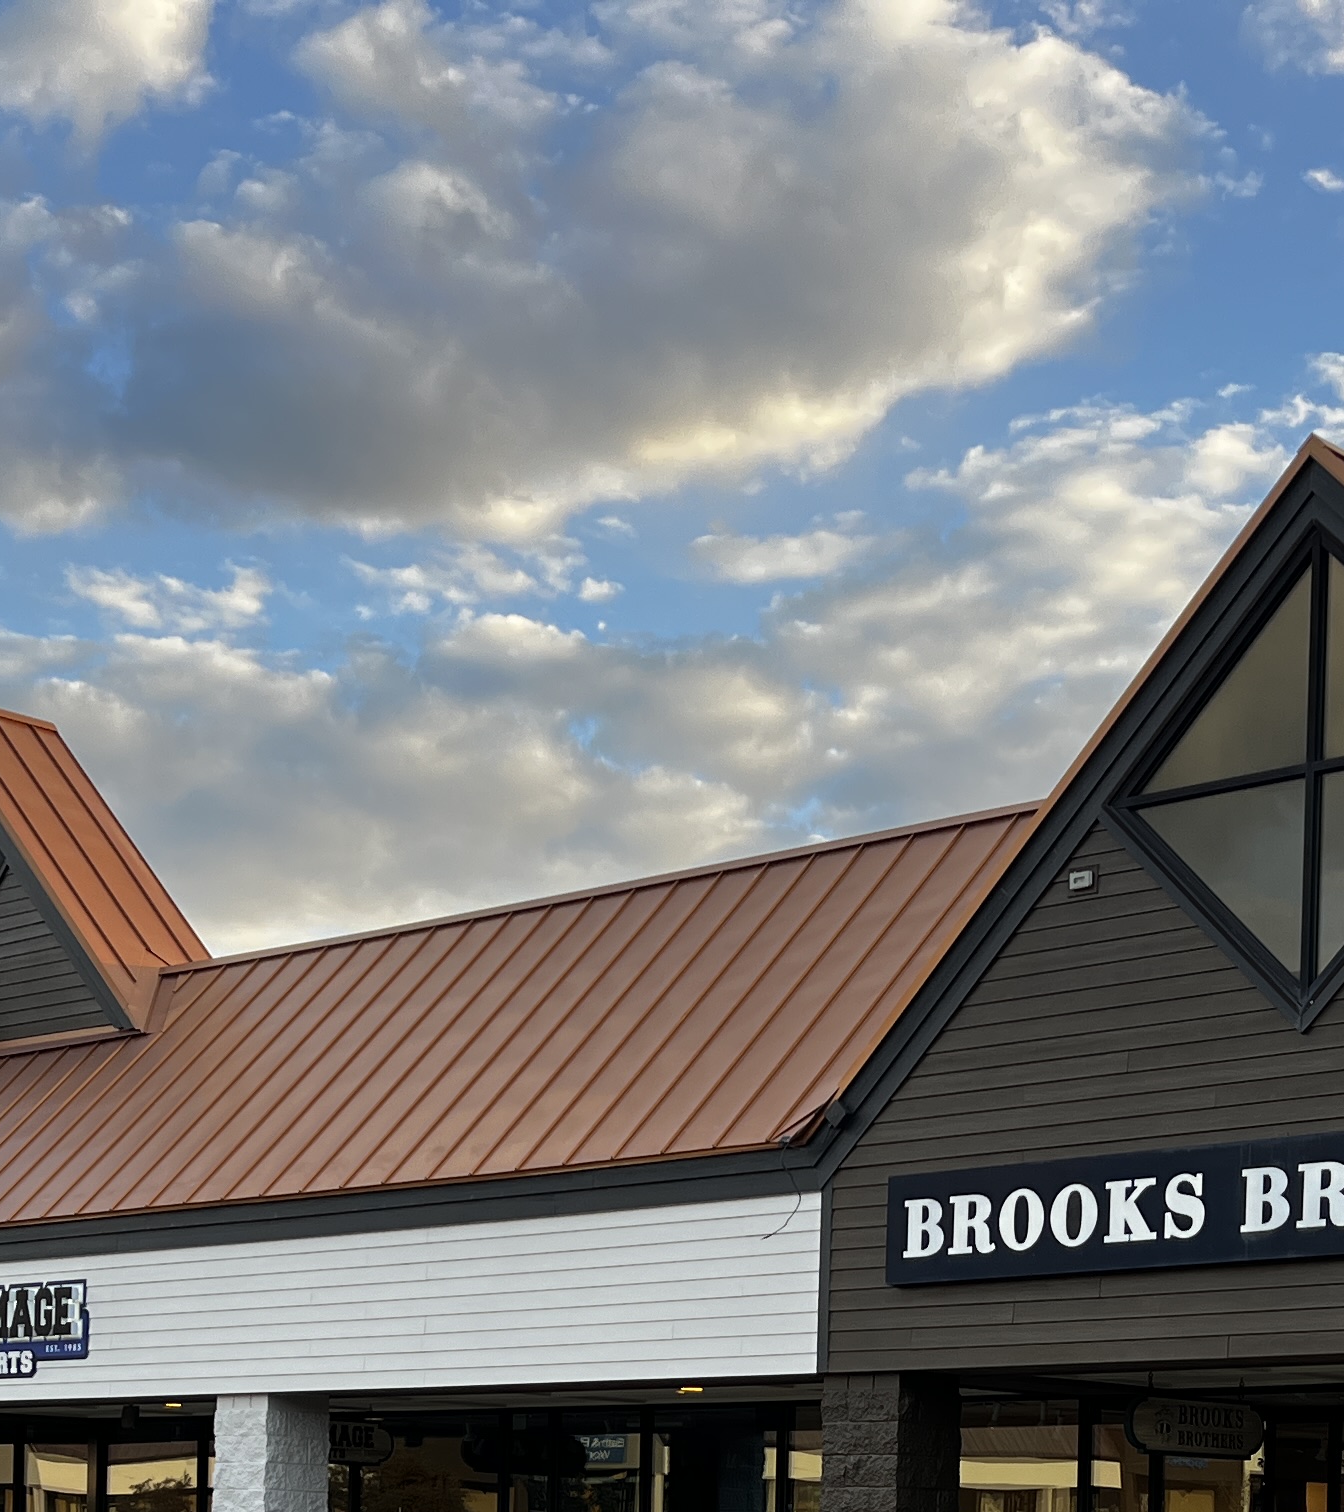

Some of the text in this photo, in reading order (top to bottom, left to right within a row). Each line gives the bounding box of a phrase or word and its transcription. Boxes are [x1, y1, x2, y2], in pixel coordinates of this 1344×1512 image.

[903, 1172, 1206, 1259] BROOKS
[45, 1343, 81, 1353] EST. 1985
[1178, 1404, 1244, 1429] BROOKS
[1178, 1431, 1244, 1450] BROTHERS
